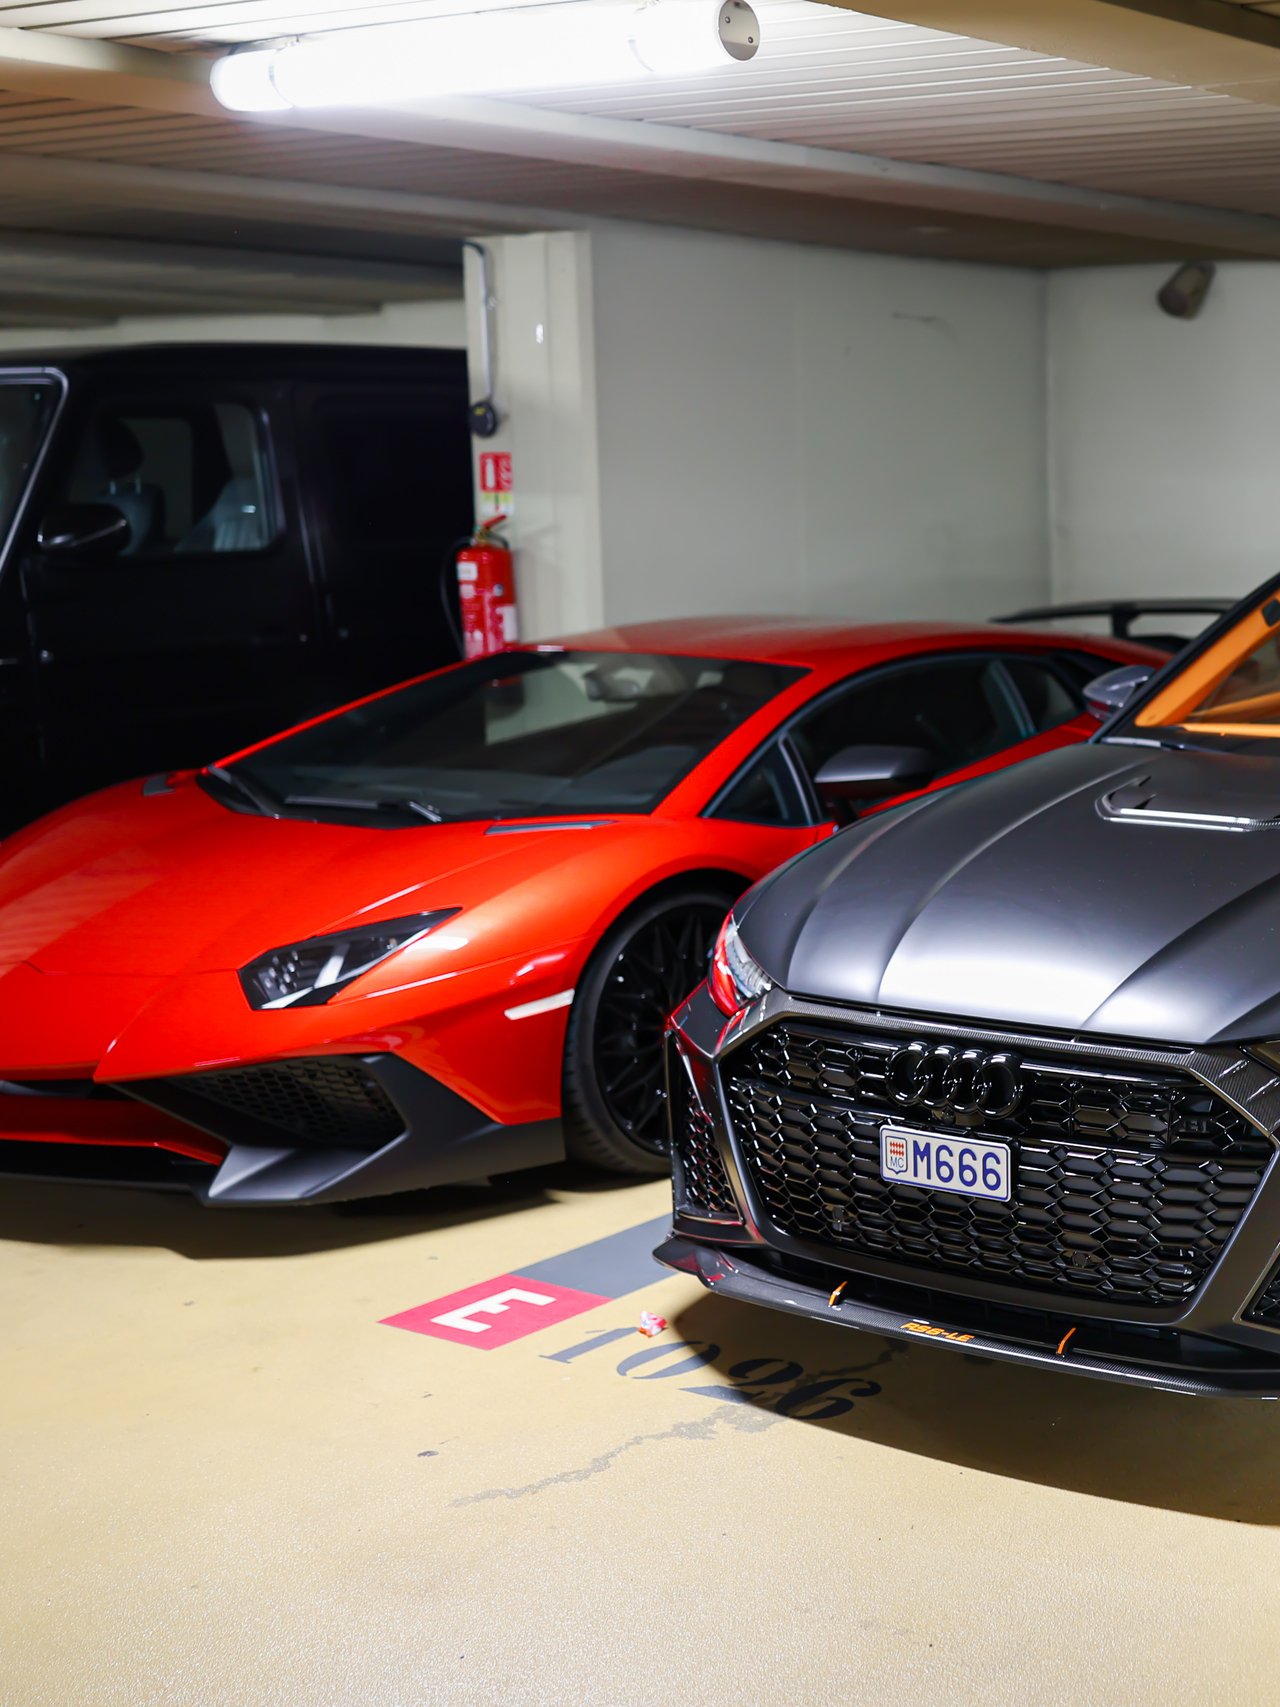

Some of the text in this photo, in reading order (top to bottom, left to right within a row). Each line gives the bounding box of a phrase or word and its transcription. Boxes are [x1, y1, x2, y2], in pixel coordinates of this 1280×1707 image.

[890, 1156, 905, 1169] MC
[912, 1140, 1001, 1191] M666
[430, 1287, 557, 1334] E
[538, 1326, 882, 1420] 1026
